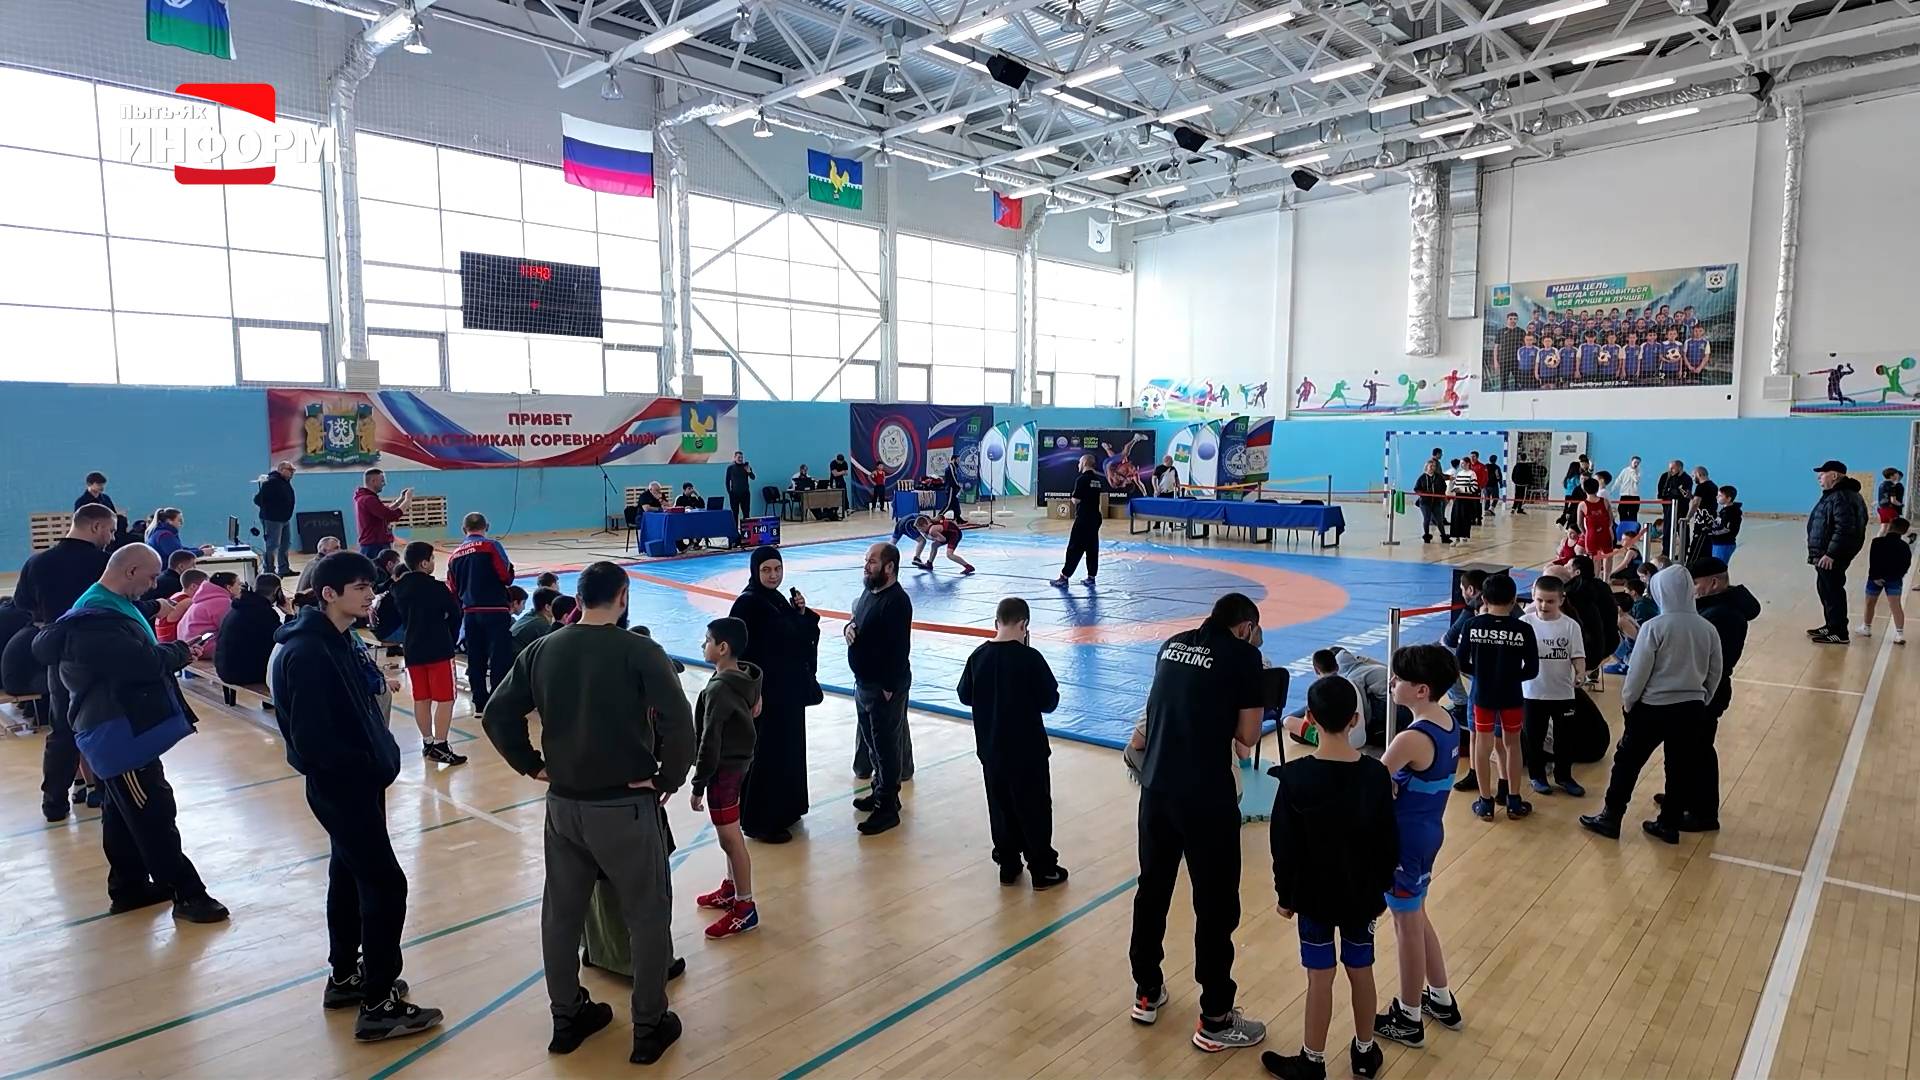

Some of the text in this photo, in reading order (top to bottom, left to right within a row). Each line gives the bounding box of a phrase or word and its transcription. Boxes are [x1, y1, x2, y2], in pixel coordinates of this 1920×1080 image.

[1552, 284, 1580, 293] НАША
[1582, 282, 1609, 291] ЦЕЛЬ
[1557, 286, 1648, 300] ВСЕГДА СТАНОВИТЬСЯ
[1574, 297, 1603, 305] ЛУЧШЕ
[1612, 294, 1645, 302] ЛУЧШЕ!
[508, 413, 572, 426] ПРИВЕТ
[755, 526, 767, 534] 1:40
[772, 528, 777, 536] 8
[1469, 628, 1524, 641] RUSSIA
[1186, 646, 1211, 655] WORLD
[1160, 648, 1214, 669] WRESTLING
